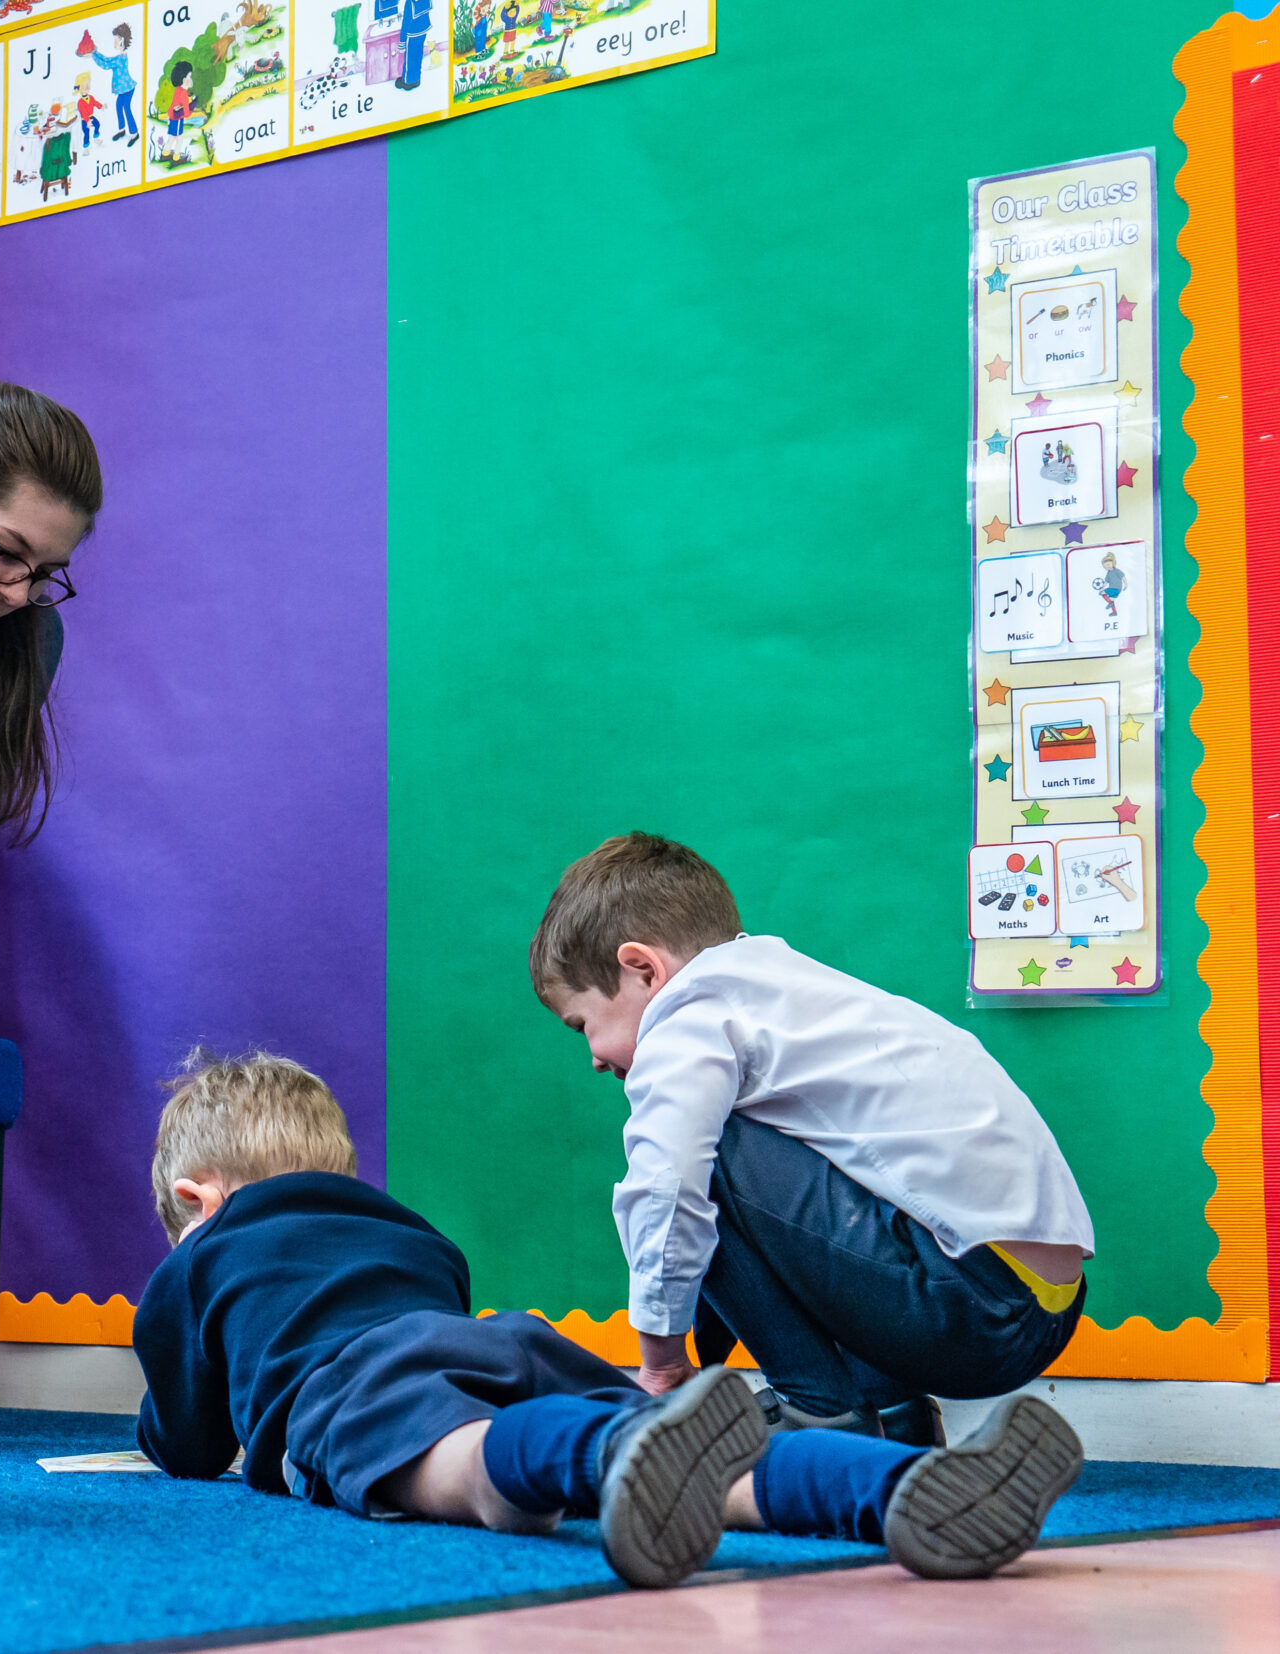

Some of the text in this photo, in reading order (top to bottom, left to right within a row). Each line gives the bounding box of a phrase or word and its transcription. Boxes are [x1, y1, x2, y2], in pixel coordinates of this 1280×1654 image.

[162, 4, 191, 28] oa
[595, 11, 687, 56] eey ore!
[23, 49, 36, 75] J
[331, 93, 374, 120] ie ie
[234, 116, 276, 152] goat
[95, 158, 127, 188] jam
[992, 180, 1137, 223] Our Class
[991, 218, 1138, 265] Timetable
[1045, 349, 1085, 362] Phonics
[1047, 495, 1078, 509] Break
[1007, 631, 1034, 641] Music
[1042, 775, 1096, 788] Lunch Time
[998, 919, 1028, 929] Maths
[1093, 914, 1109, 924] Art
